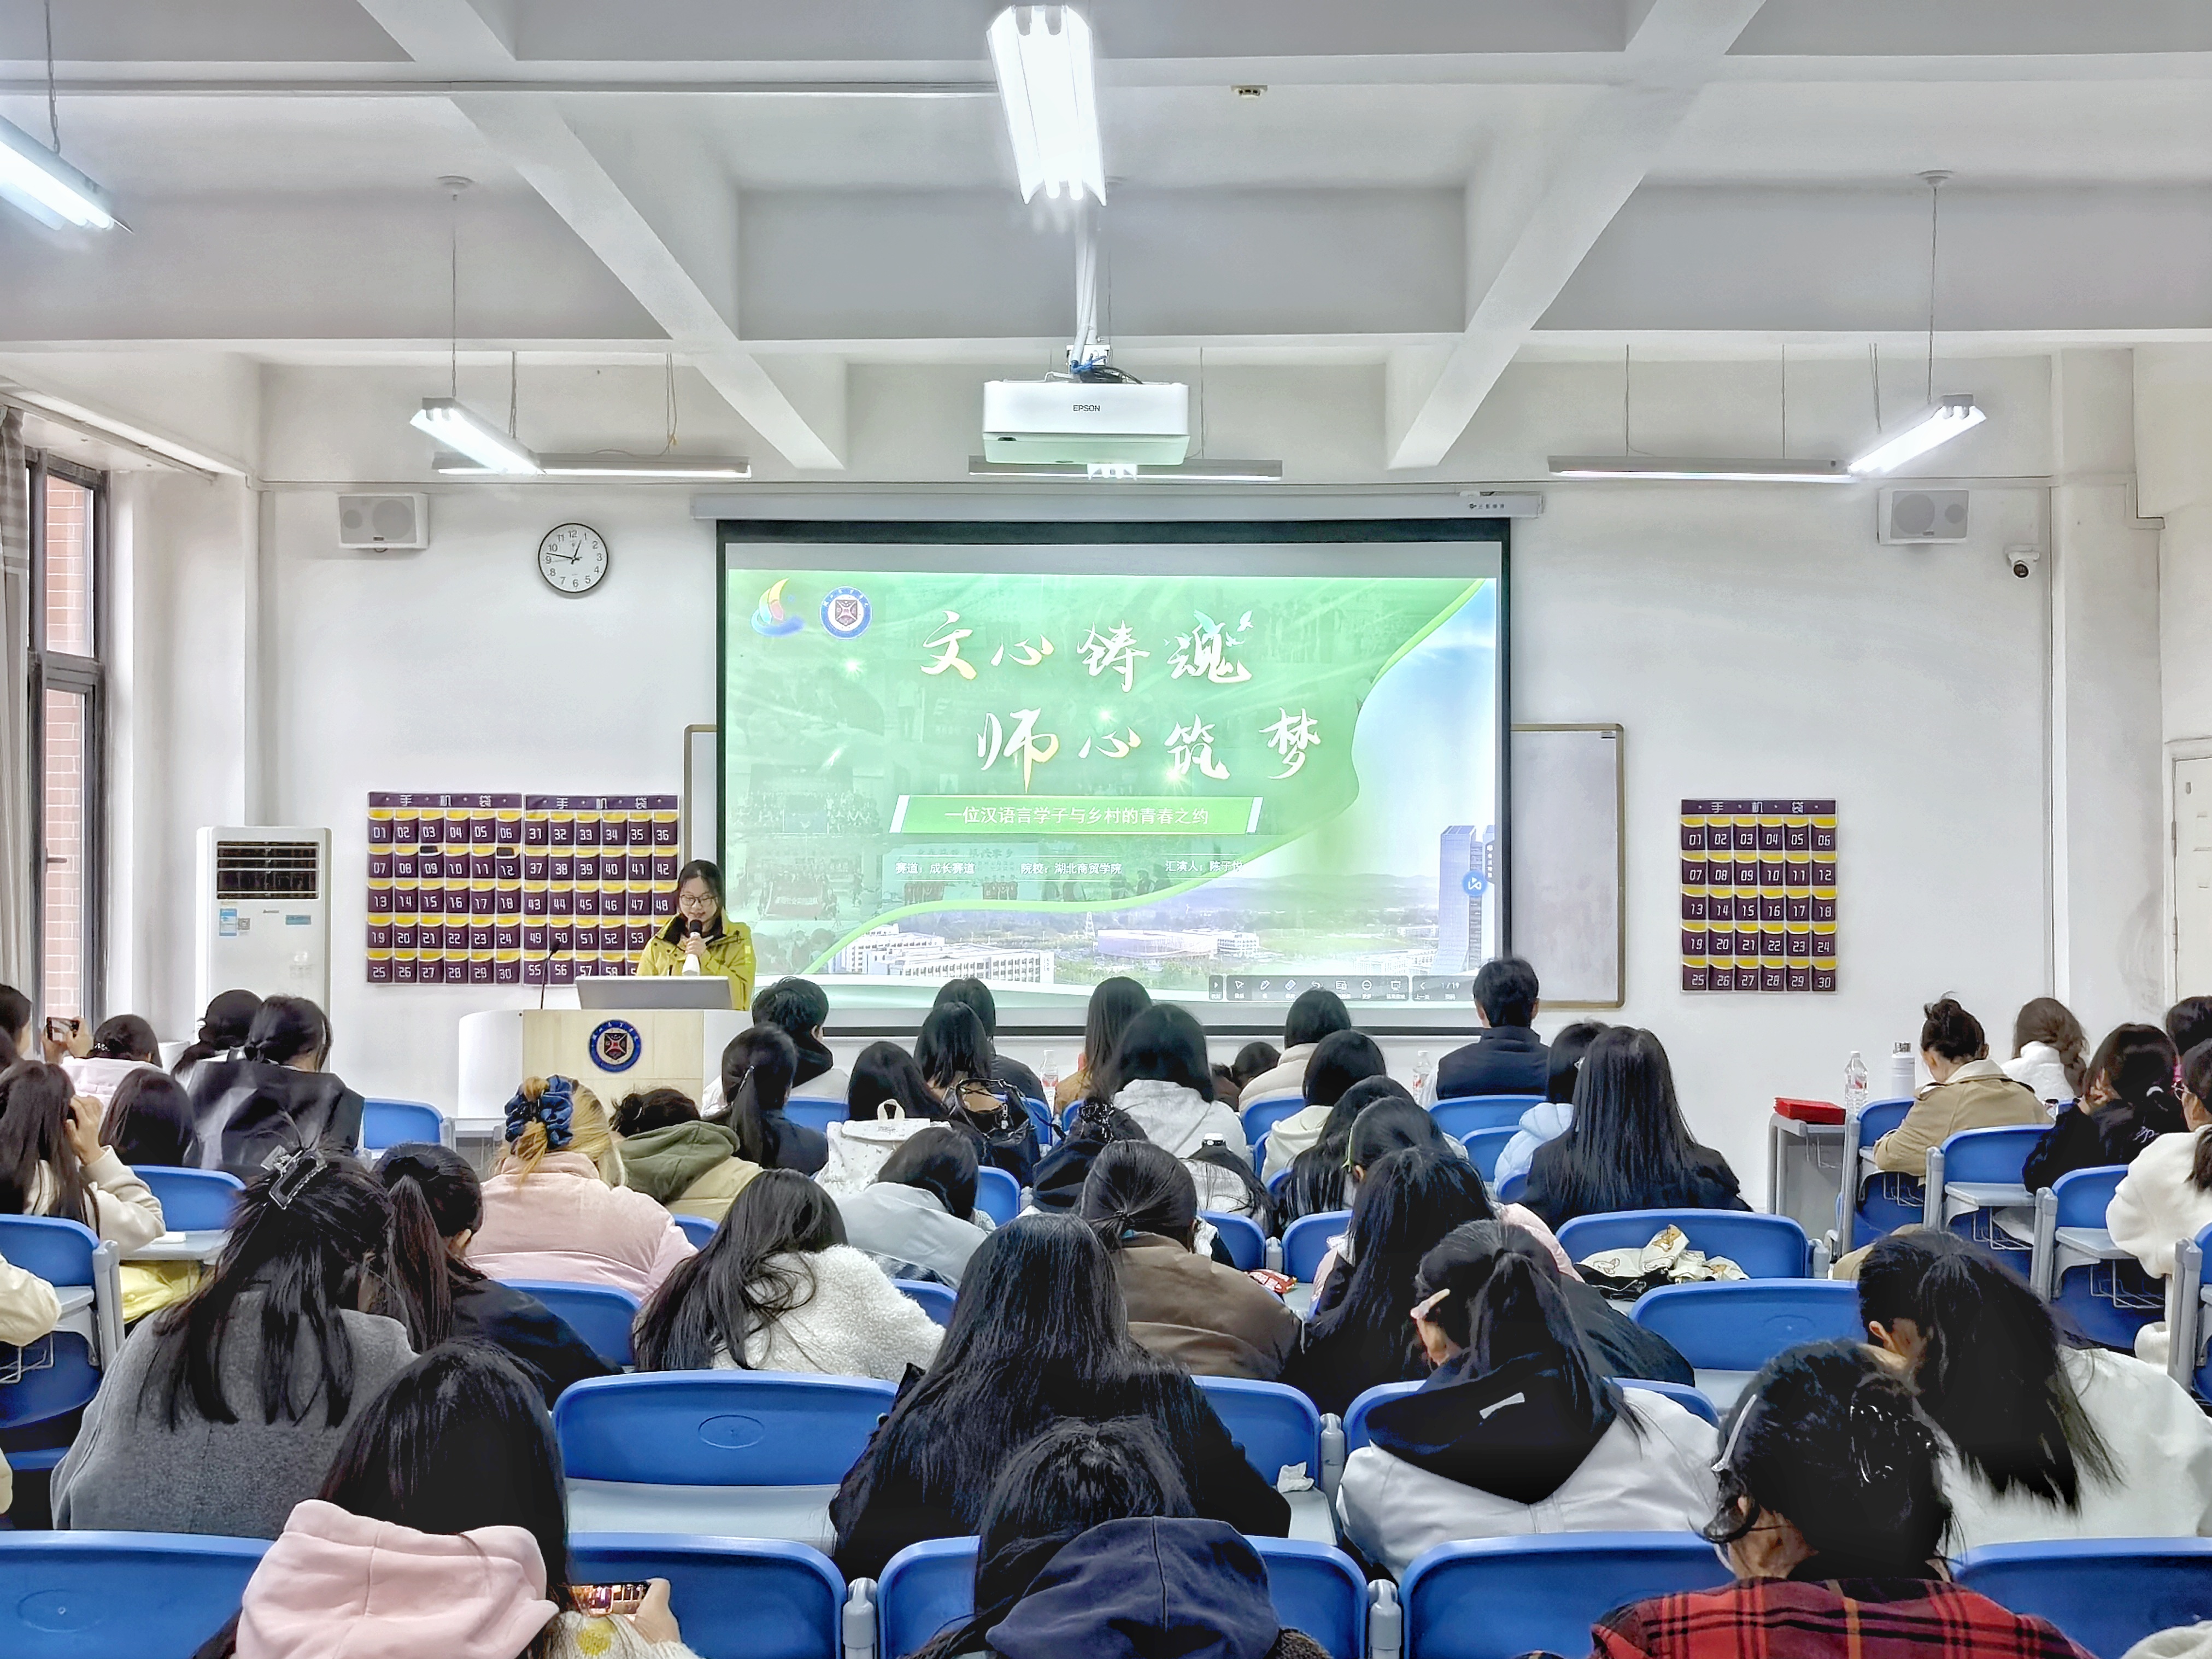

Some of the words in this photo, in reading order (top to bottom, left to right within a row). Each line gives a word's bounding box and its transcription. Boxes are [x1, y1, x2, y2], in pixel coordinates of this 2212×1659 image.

[568, 530, 577, 538] 12
[548, 543, 558, 552] 10
[592, 541, 599, 549] 2
[545, 555, 551, 564] 9
[597, 553, 603, 561] 3
[550, 568, 556, 576] 8
[560, 576, 566, 584] 7
[572, 579, 579, 588] 6
[585, 576, 591, 584] 5
[944, 806, 1209, 825] 一位汉语言学子与乡村的青春之约
[373, 826, 386, 839] 01
[397, 826, 410, 838] 02
[423, 826, 436, 838] 03
[449, 827, 462, 839] 04
[474, 826, 487, 838] 05
[500, 827, 513, 839] 06
[529, 828, 542, 840] 31
[554, 829, 567, 840] 32
[579, 829, 592, 840] 33
[605, 829, 618, 841] 34
[630, 829, 643, 840] 35
[656, 829, 669, 841] 36
[1689, 834, 1701, 846] 01
[1714, 833, 1727, 845] 02
[1740, 833, 1753, 845] 03
[1766, 833, 1778, 845] 04
[1791, 833, 1804, 846] 05
[1818, 834, 1830, 847] 06
[373, 862, 386, 874] 07
[398, 863, 412, 874] 08
[424, 863, 438, 874] 09
[449, 863, 462, 875] 10
[476, 863, 489, 875] 11
[500, 865, 515, 876] 12
[530, 863, 543, 874] 37
[555, 863, 568, 875] 38
[580, 863, 593, 875] 39
[605, 863, 618, 875] 40
[632, 863, 644, 875] 41
[657, 863, 670, 875] 42
[1689, 869, 1703, 881] 07
[1715, 869, 1728, 881] 08
[1741, 870, 1753, 882] 09
[1767, 870, 1780, 882] 10
[1793, 870, 1805, 882] 11
[1818, 869, 1832, 881] 12
[374, 896, 388, 908] 13
[399, 895, 412, 908] 14
[424, 896, 437, 908] 15
[449, 897, 463, 908] 16
[474, 898, 487, 909] 17
[501, 897, 513, 909] 18
[528, 899, 541, 910] 43
[553, 898, 566, 910] 44
[579, 899, 592, 910] 45
[605, 899, 617, 911] 46
[631, 899, 643, 911] 47
[655, 899, 668, 911] 48
[1691, 904, 1704, 916] 13
[1717, 905, 1729, 917] 14
[1742, 905, 1755, 917] 15
[1768, 905, 1781, 917] 16
[1793, 905, 1805, 917] 17
[1819, 906, 1832, 918] 18
[372, 932, 385, 944] 19
[397, 932, 410, 944] 20
[422, 933, 436, 944] 21
[448, 933, 461, 945] 22
[473, 933, 487, 945] 23
[499, 933, 512, 944] 24
[530, 932, 542, 944] 49
[580, 933, 593, 944] 51
[604, 933, 618, 944] 52
[631, 932, 644, 943] 53
[1691, 939, 1703, 950] 19
[1716, 938, 1729, 951] 20
[1742, 939, 1755, 951] 21
[1768, 940, 1781, 952] 22
[1792, 941, 1805, 953] 23
[1817, 941, 1830, 953] 24
[372, 966, 386, 978] 25
[398, 966, 412, 978] 26
[421, 967, 435, 978] 27
[448, 967, 461, 978] 28
[474, 967, 487, 979] 29
[498, 968, 512, 980] 30
[529, 964, 541, 976] 55
[555, 964, 567, 976] 56
[580, 966, 592, 976] 57
[1692, 974, 1705, 986] 25
[1717, 975, 1730, 987] 26
[1741, 975, 1755, 987] 27
[1767, 975, 1780, 986] 28
[1791, 975, 1804, 987] 29
[1817, 976, 1831, 988] 30
